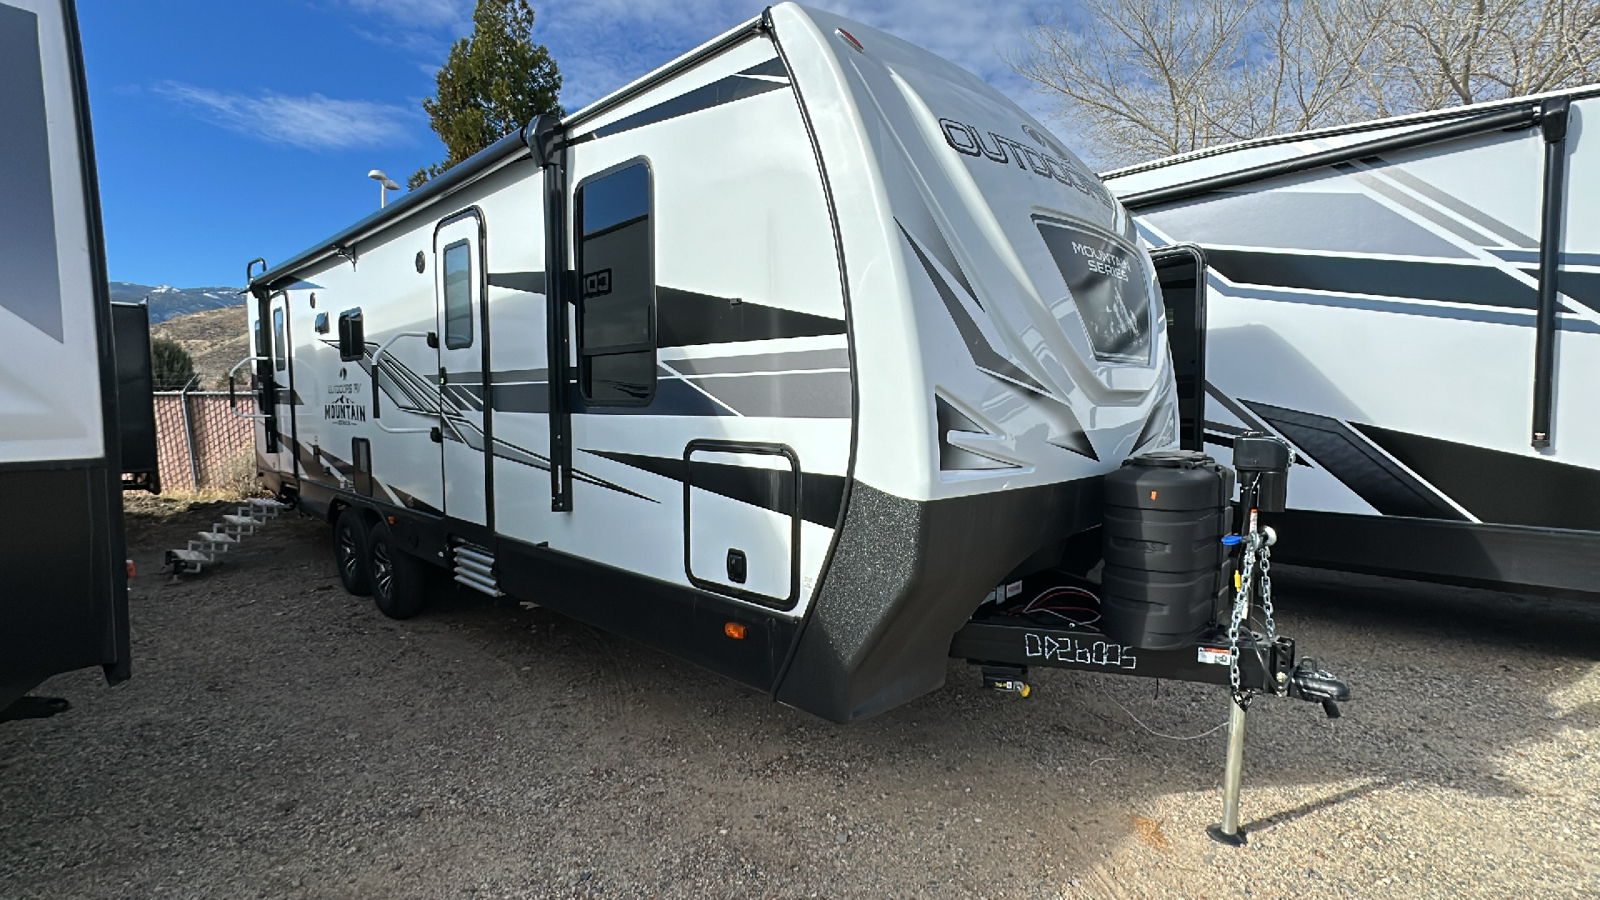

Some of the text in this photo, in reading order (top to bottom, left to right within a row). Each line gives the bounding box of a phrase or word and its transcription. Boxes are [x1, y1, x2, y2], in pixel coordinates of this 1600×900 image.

[1071, 241, 1131, 272] MOUNTAIN
[1087, 260, 1129, 282] SERIES
[325, 405, 366, 422] MOUNTAIN
